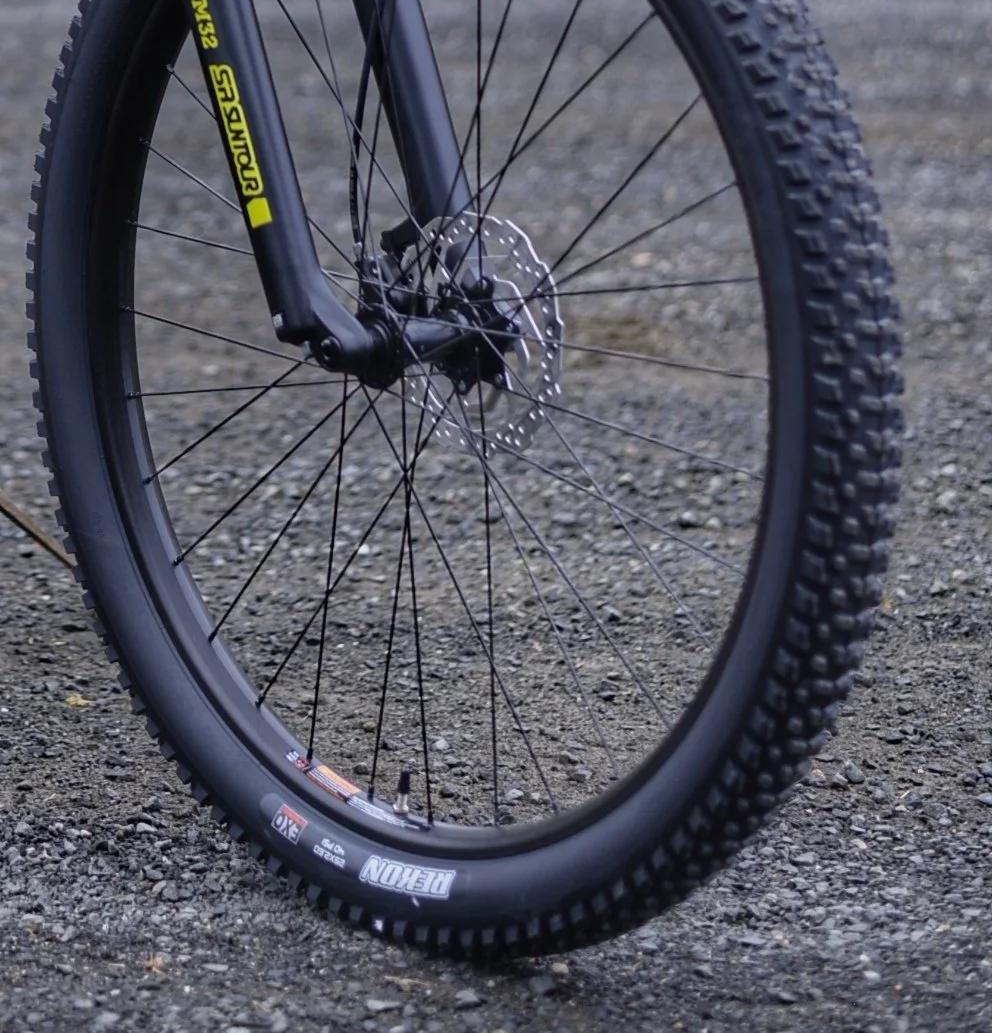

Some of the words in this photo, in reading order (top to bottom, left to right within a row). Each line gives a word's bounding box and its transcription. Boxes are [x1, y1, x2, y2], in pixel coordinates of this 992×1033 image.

[223, 105, 261, 195] SUNTOUR
[272, 812, 305, 843] EXO
[359, 854, 457, 900] REKON
